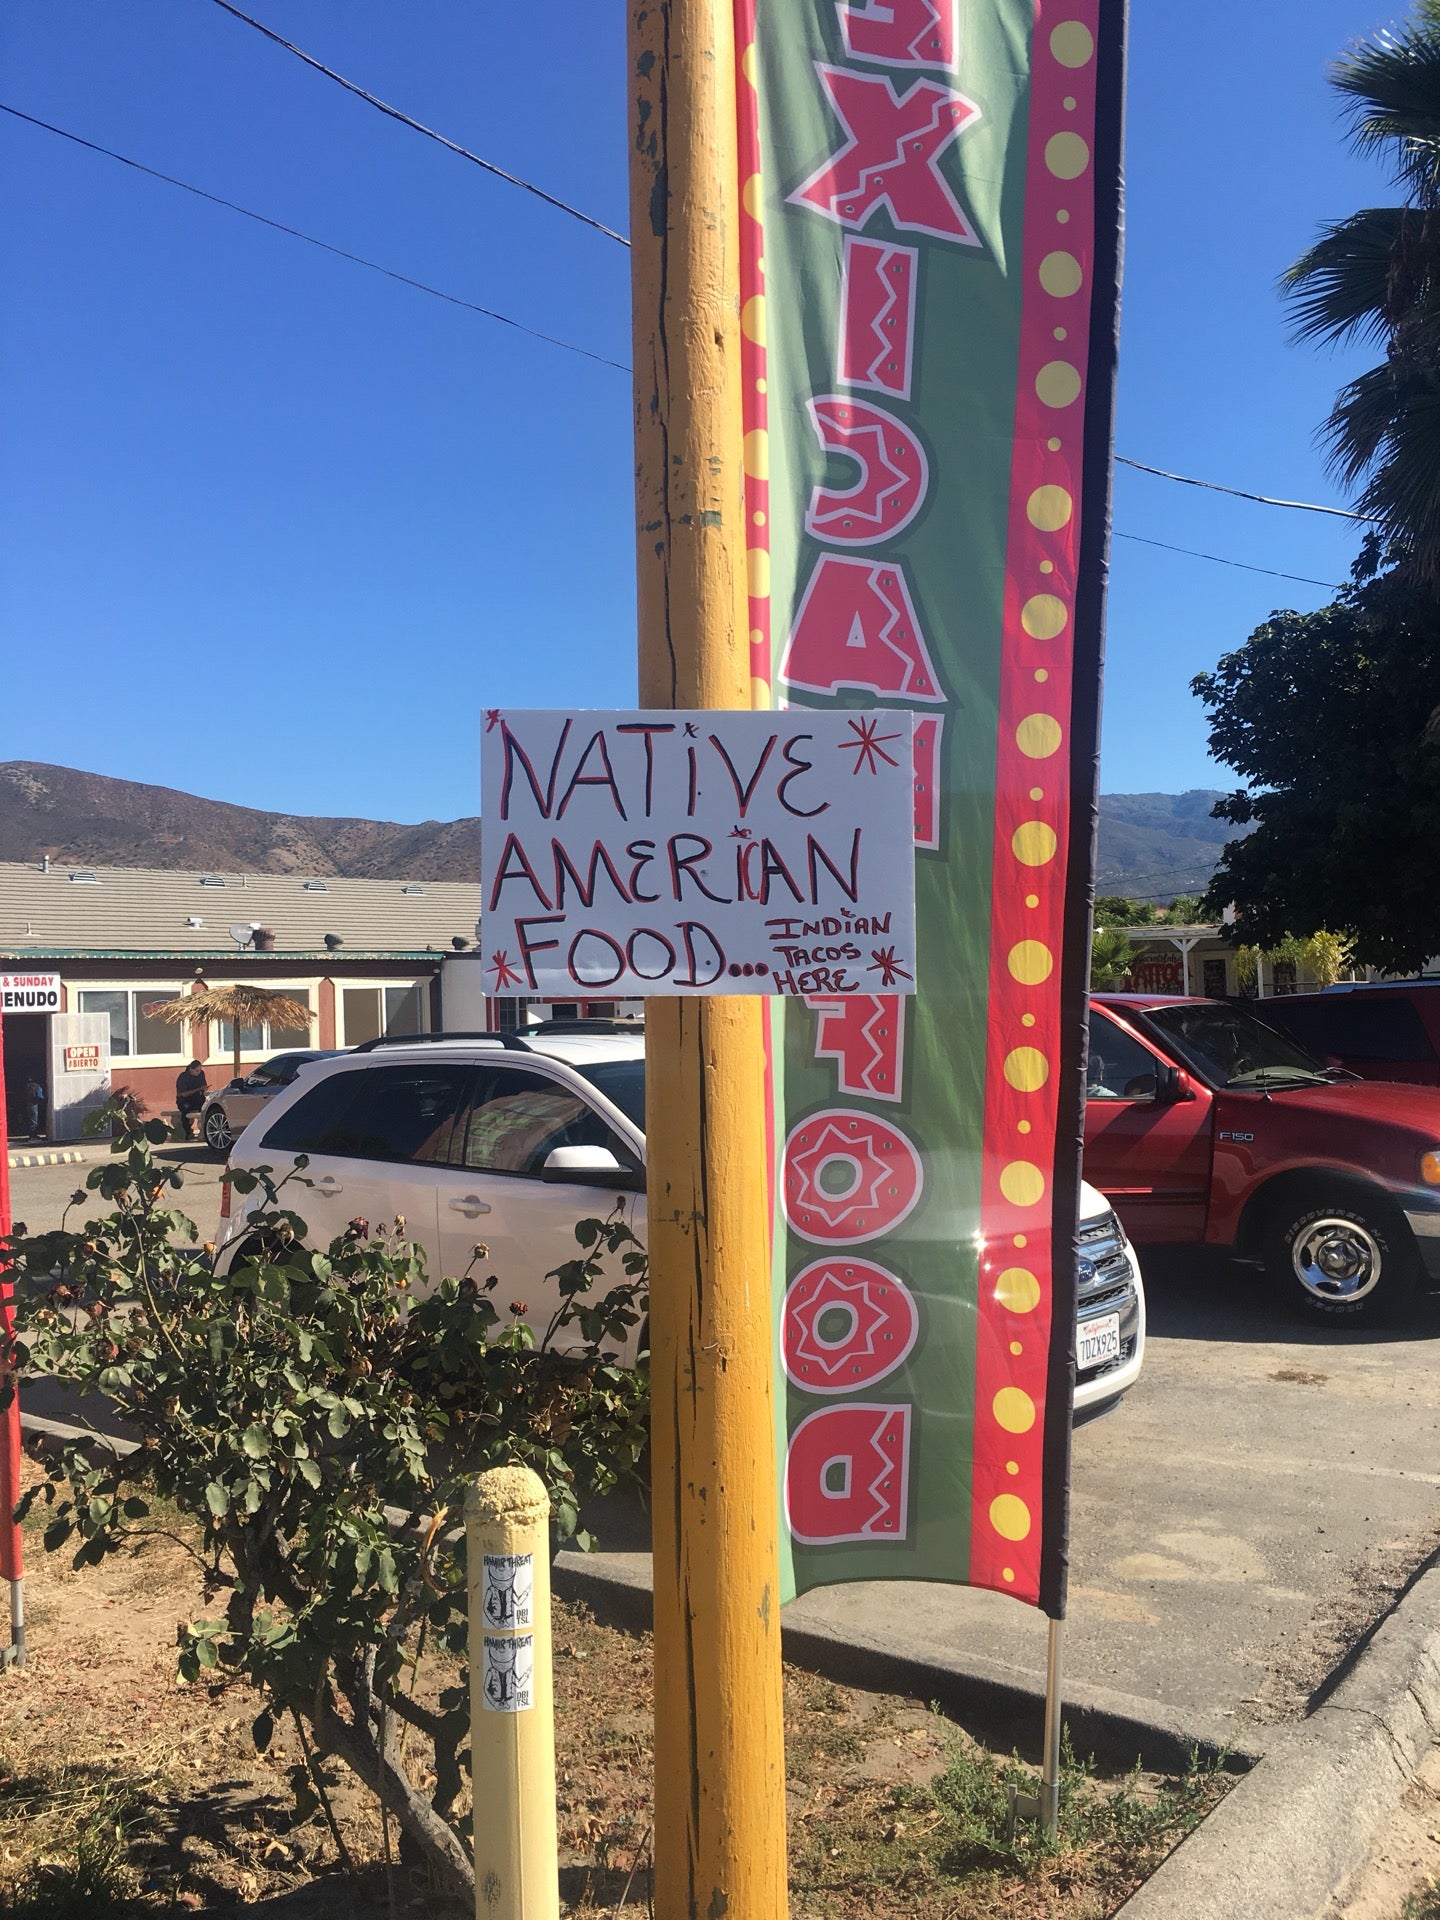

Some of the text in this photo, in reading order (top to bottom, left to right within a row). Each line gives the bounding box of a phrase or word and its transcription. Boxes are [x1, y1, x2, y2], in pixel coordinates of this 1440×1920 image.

[772, 942, 862, 967] TACOS
[3, 976, 54, 987] & SUNDAY
[772, 968, 860, 995] HERE
[0, 991, 58, 1007] ENUDO
[70, 1047, 96, 1058] OPEN
[68, 1058, 99, 1068] ABIERTO
[1080, 1330, 1118, 1361] 7DZX925
